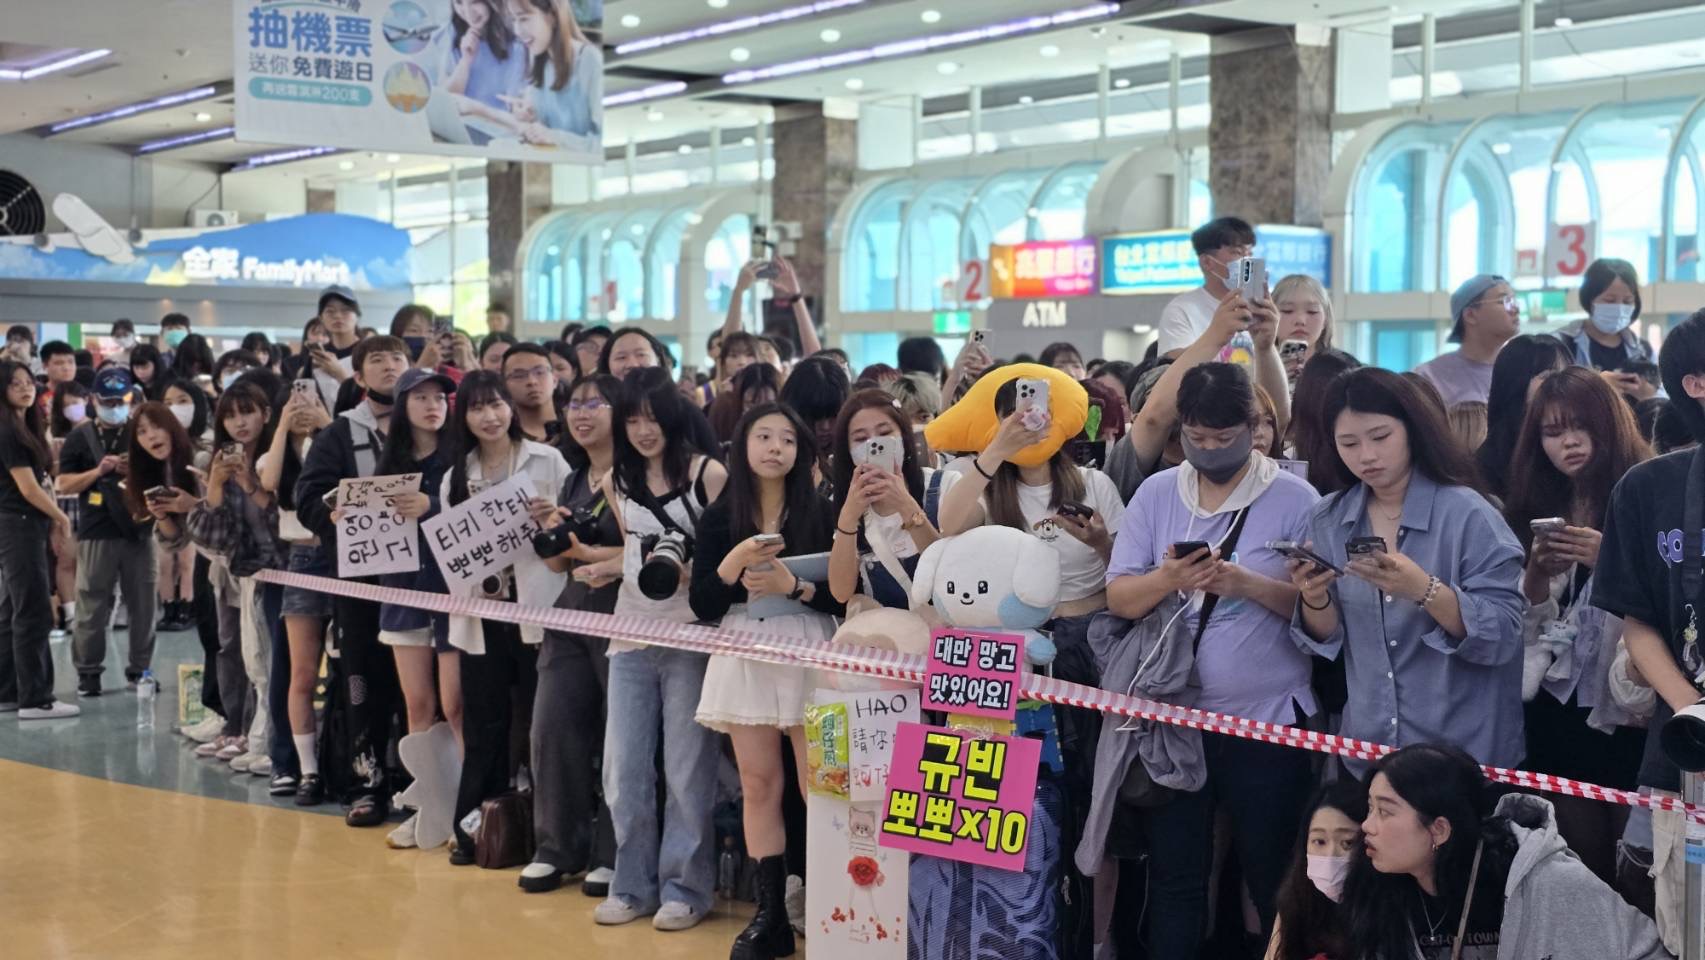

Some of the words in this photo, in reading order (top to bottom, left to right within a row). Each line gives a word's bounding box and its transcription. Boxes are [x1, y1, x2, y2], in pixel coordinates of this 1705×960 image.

[248, 7, 372, 57] 抽機票
[293, 56, 373, 82] 免費遊日
[182, 246, 239, 278] 全家
[244, 257, 350, 287] FamilyMart
[1557, 225, 1588, 276] 3
[965, 260, 983, 302] 2
[1022, 301, 1067, 327] ATM
[435, 509, 481, 551] 티키
[934, 635, 973, 667] 대만
[978, 640, 1017, 672] 망고
[855, 694, 907, 718] HAO
[929, 673, 1013, 710] 맛있어요!
[851, 728, 897, 754] 請你
[919, 732, 1007, 803] 규빈
[882, 788, 1027, 856] 뽀뽀x10
